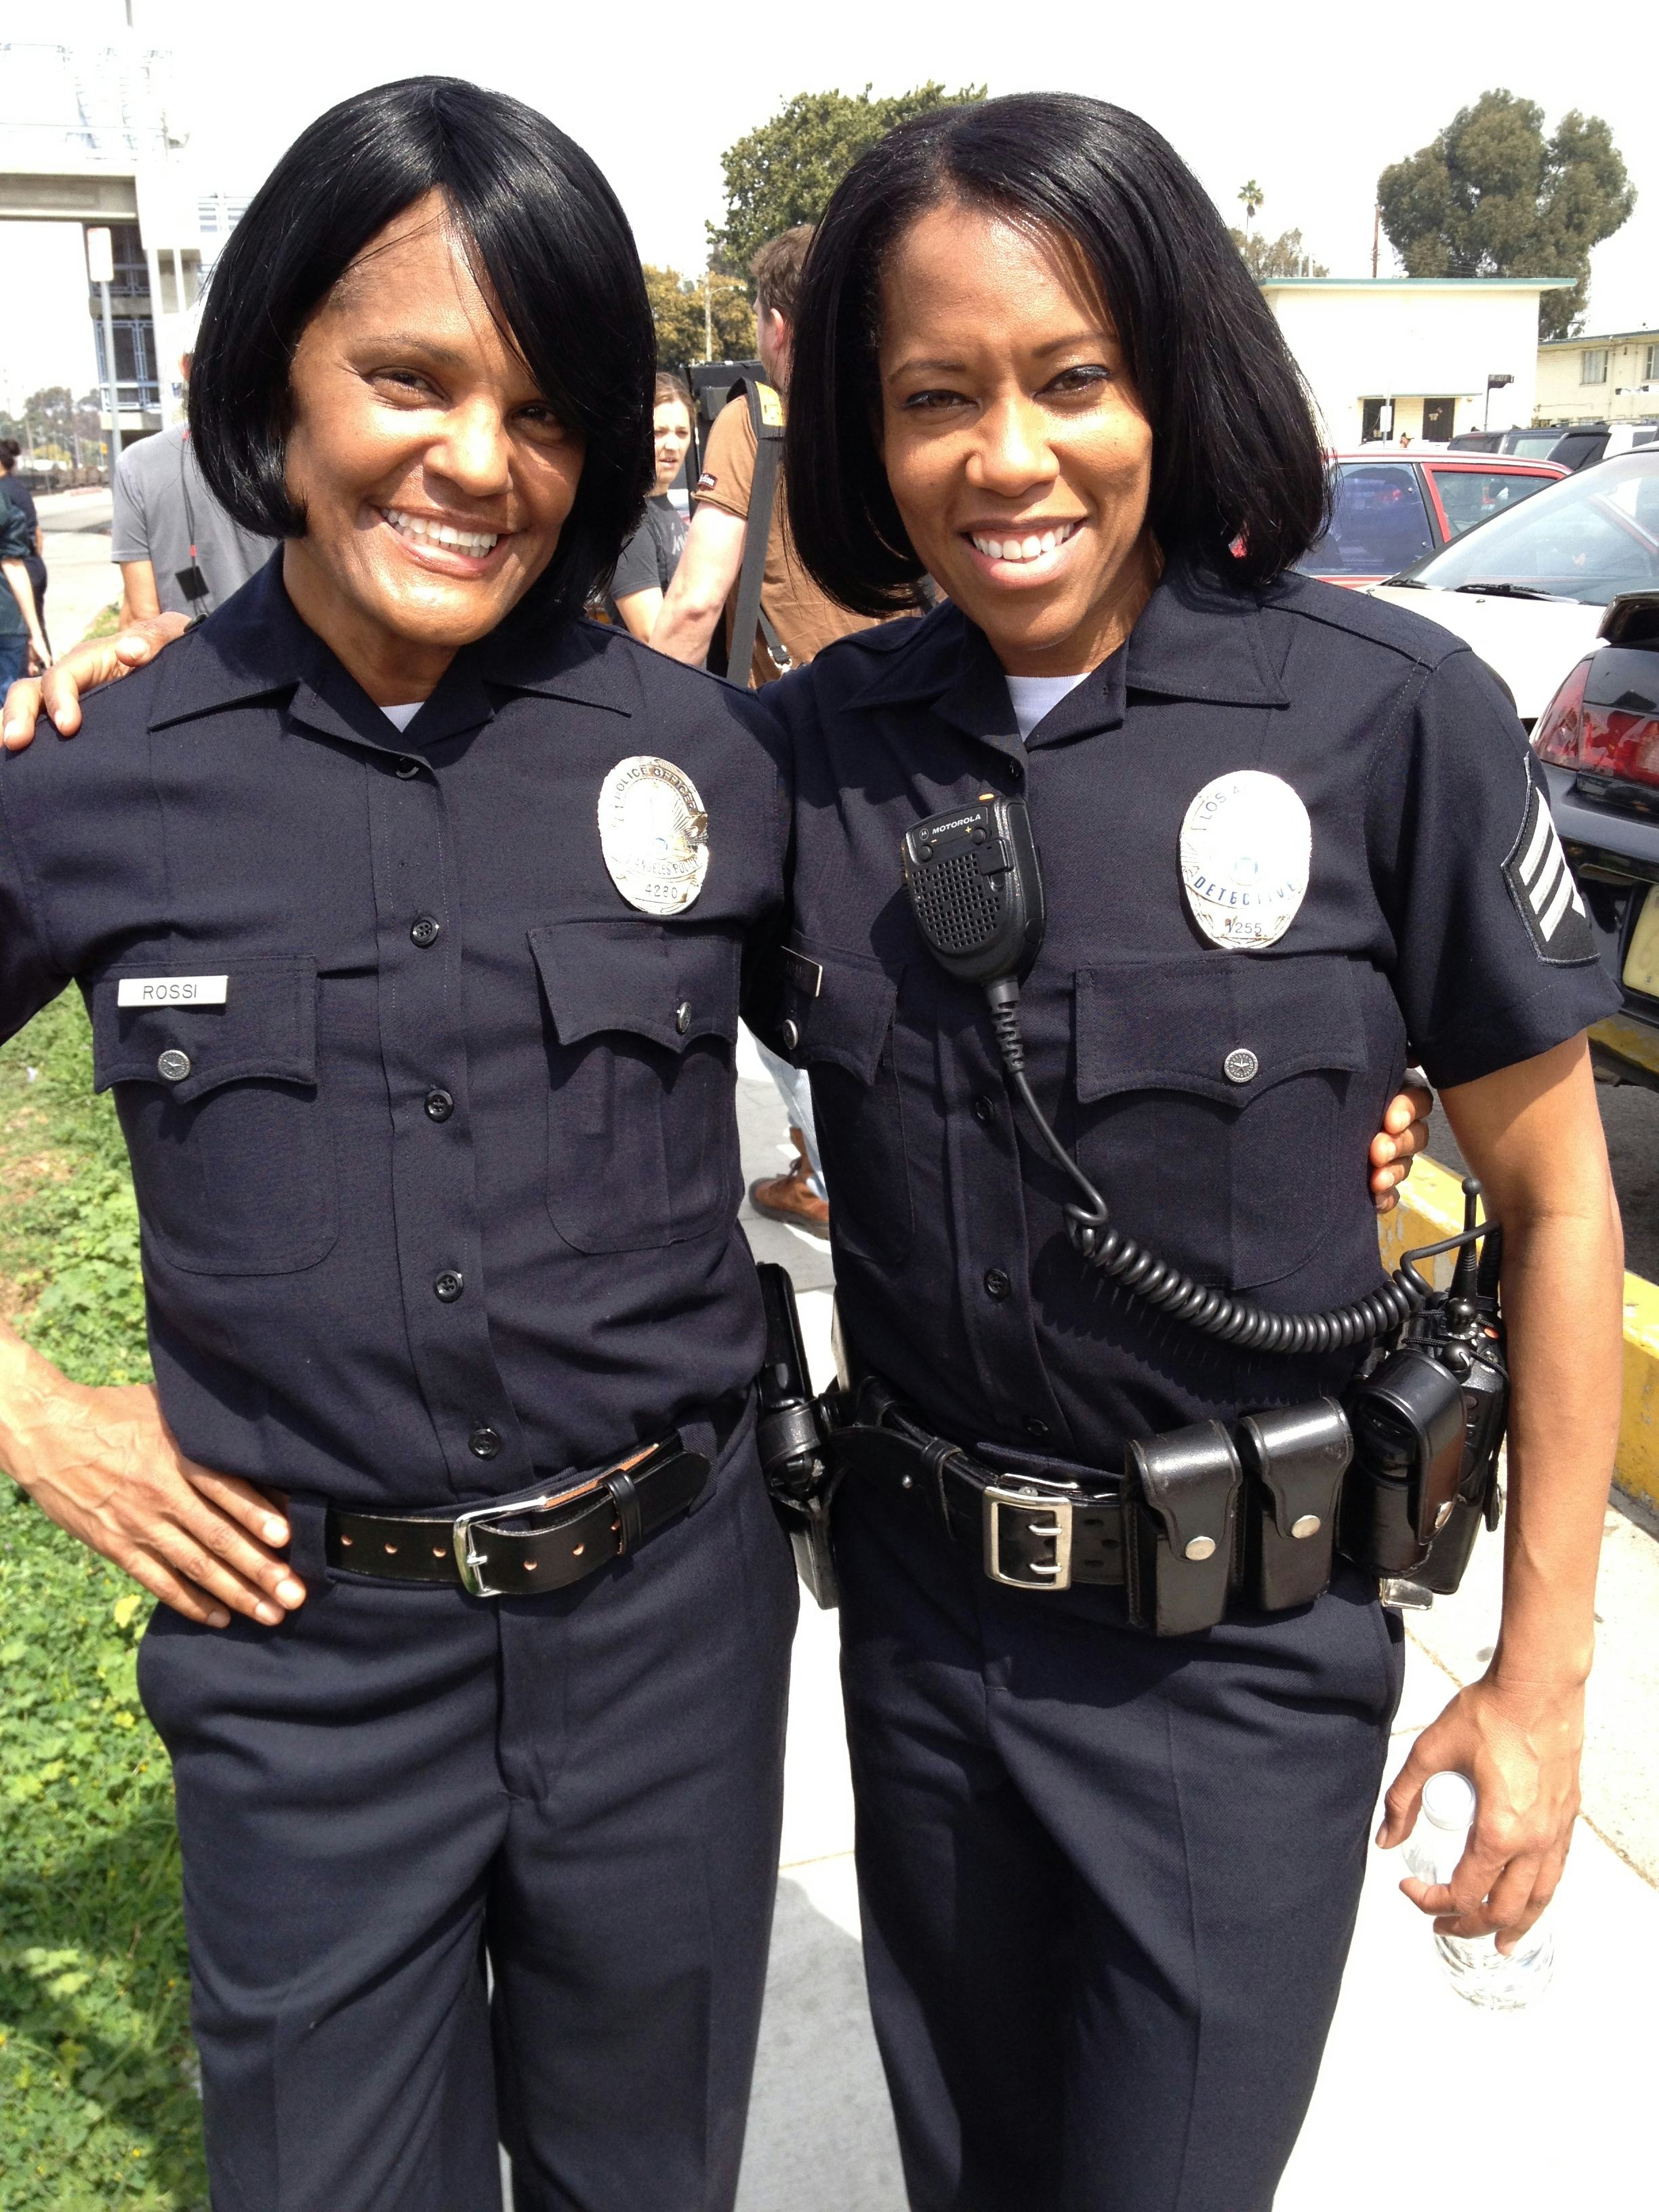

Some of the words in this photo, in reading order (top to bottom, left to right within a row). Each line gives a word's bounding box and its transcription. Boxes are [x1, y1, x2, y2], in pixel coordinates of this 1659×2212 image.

[653, 766, 697, 809] OFFICER
[1200, 792, 1227, 820] LOS
[932, 813, 981, 834] MOTOROLA
[143, 984, 197, 1000] ROSSI
